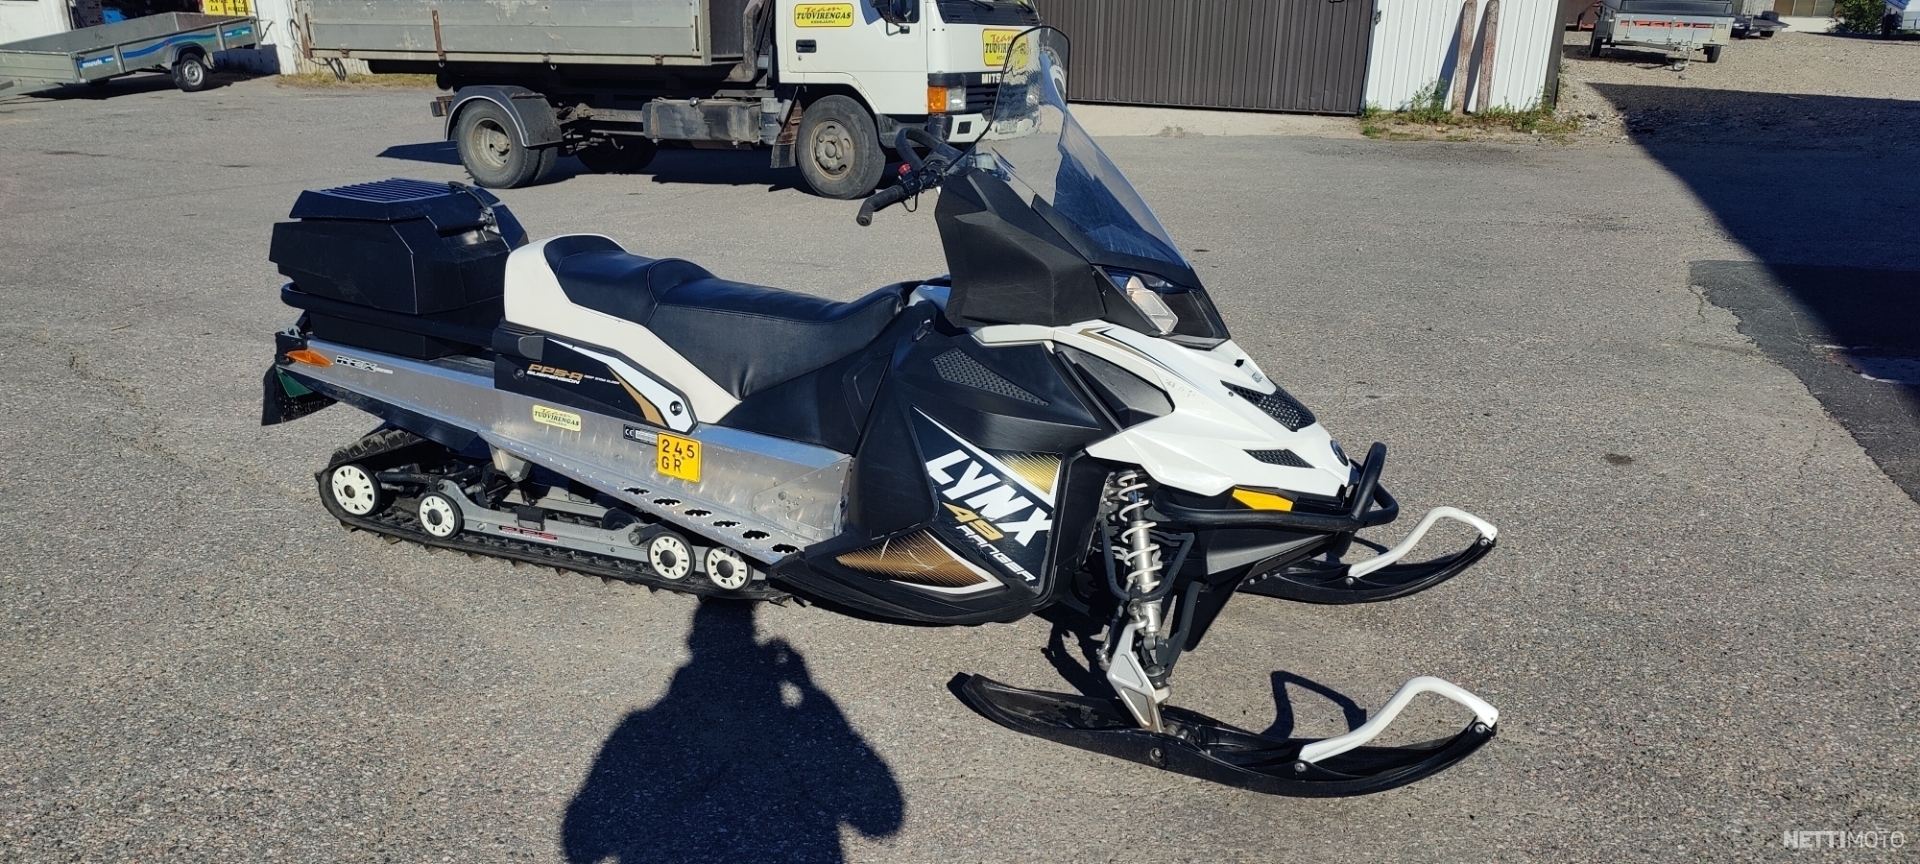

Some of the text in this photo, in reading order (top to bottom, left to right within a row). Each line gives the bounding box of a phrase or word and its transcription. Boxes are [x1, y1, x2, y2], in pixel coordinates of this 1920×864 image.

[797, 12, 851, 20] TUOVIRENGAS
[804, 6, 843, 14] Team
[526, 370, 580, 385] SUSPENSION
[528, 363, 584, 381] PPS-A
[534, 411, 580, 426] TUOVIRENGAS
[662, 439, 695, 459] 245
[662, 456, 682, 474] GR
[925, 449, 1053, 548] LYNX
[941, 501, 1004, 542] 49
[955, 524, 1037, 582] RANGER
